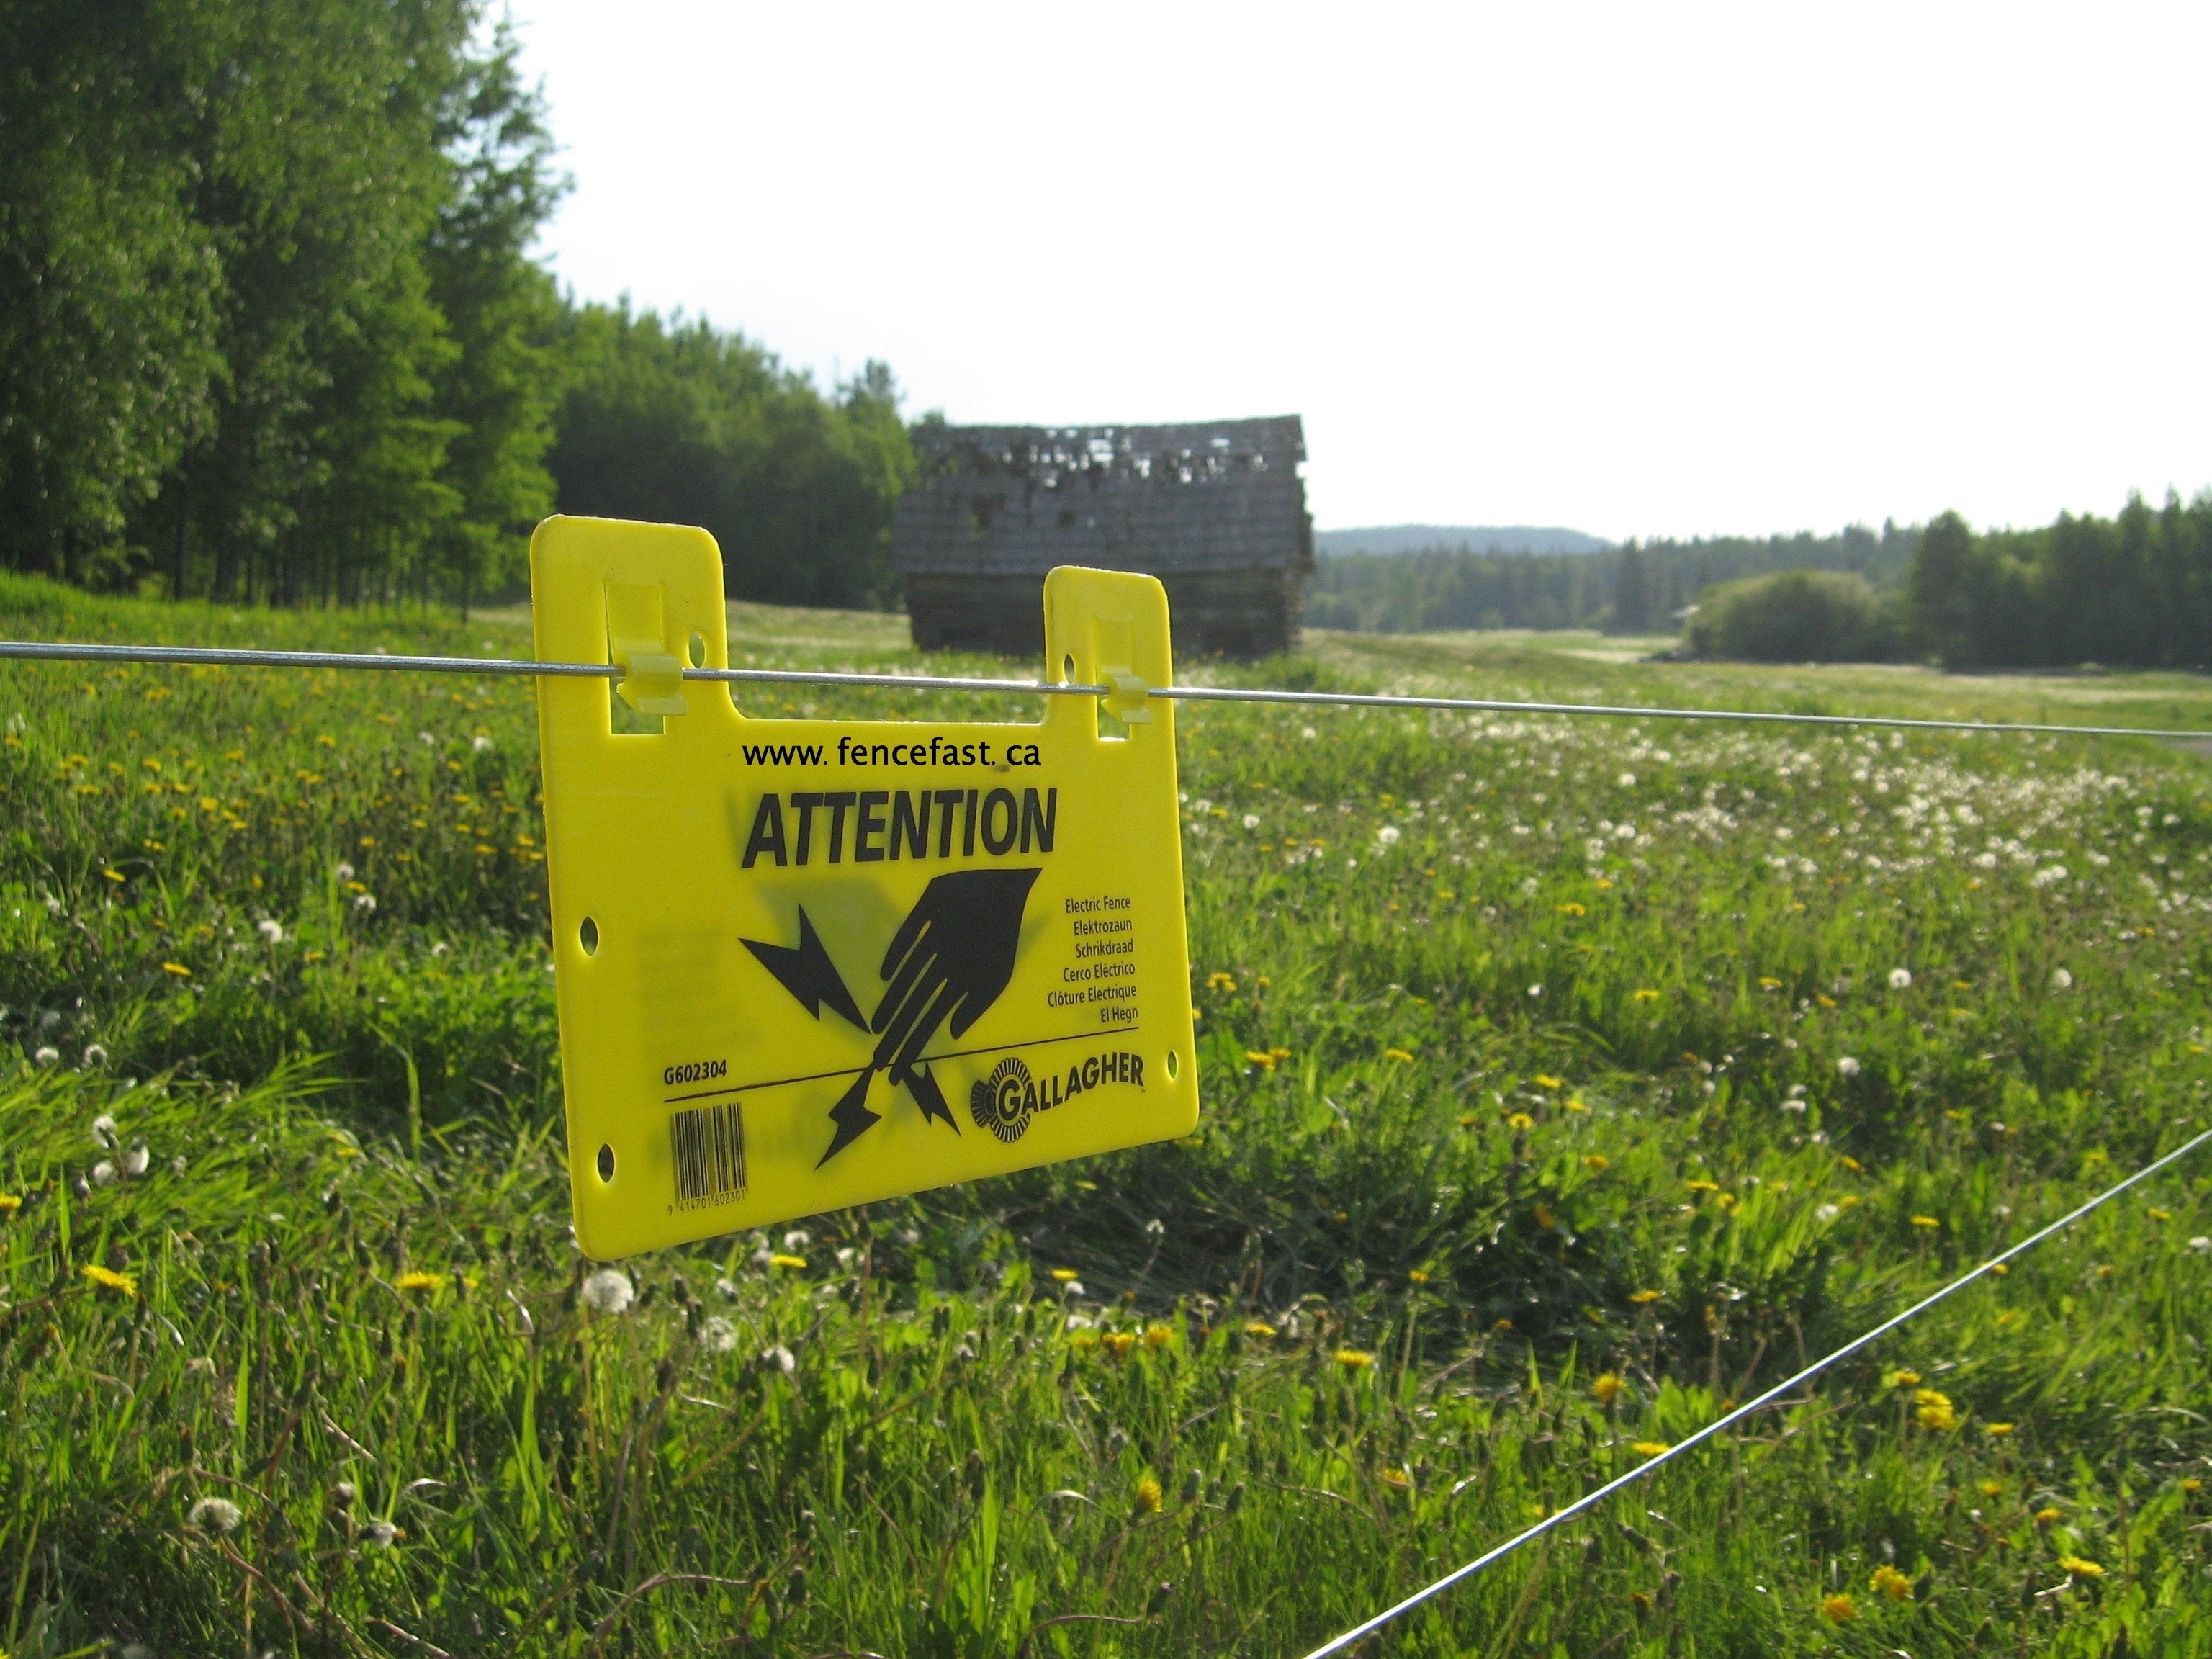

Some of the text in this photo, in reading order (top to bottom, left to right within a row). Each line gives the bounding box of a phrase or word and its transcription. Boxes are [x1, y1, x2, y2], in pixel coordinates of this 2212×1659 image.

[741, 787, 1058, 868] ATTENTION
[1065, 896, 1131, 914] Electric Fence
[1074, 919, 1133, 936] Elektrozaun
[1076, 938, 1134, 958] Schrikdraad
[1063, 961, 1136, 982] Cerco Eléctrico
[1048, 984, 1137, 1007] Clôture Electrique
[1100, 1007, 1138, 1023] El Hegn
[664, 1059, 727, 1085] G602304
[998, 1051, 1144, 1121] GALLAGHER
